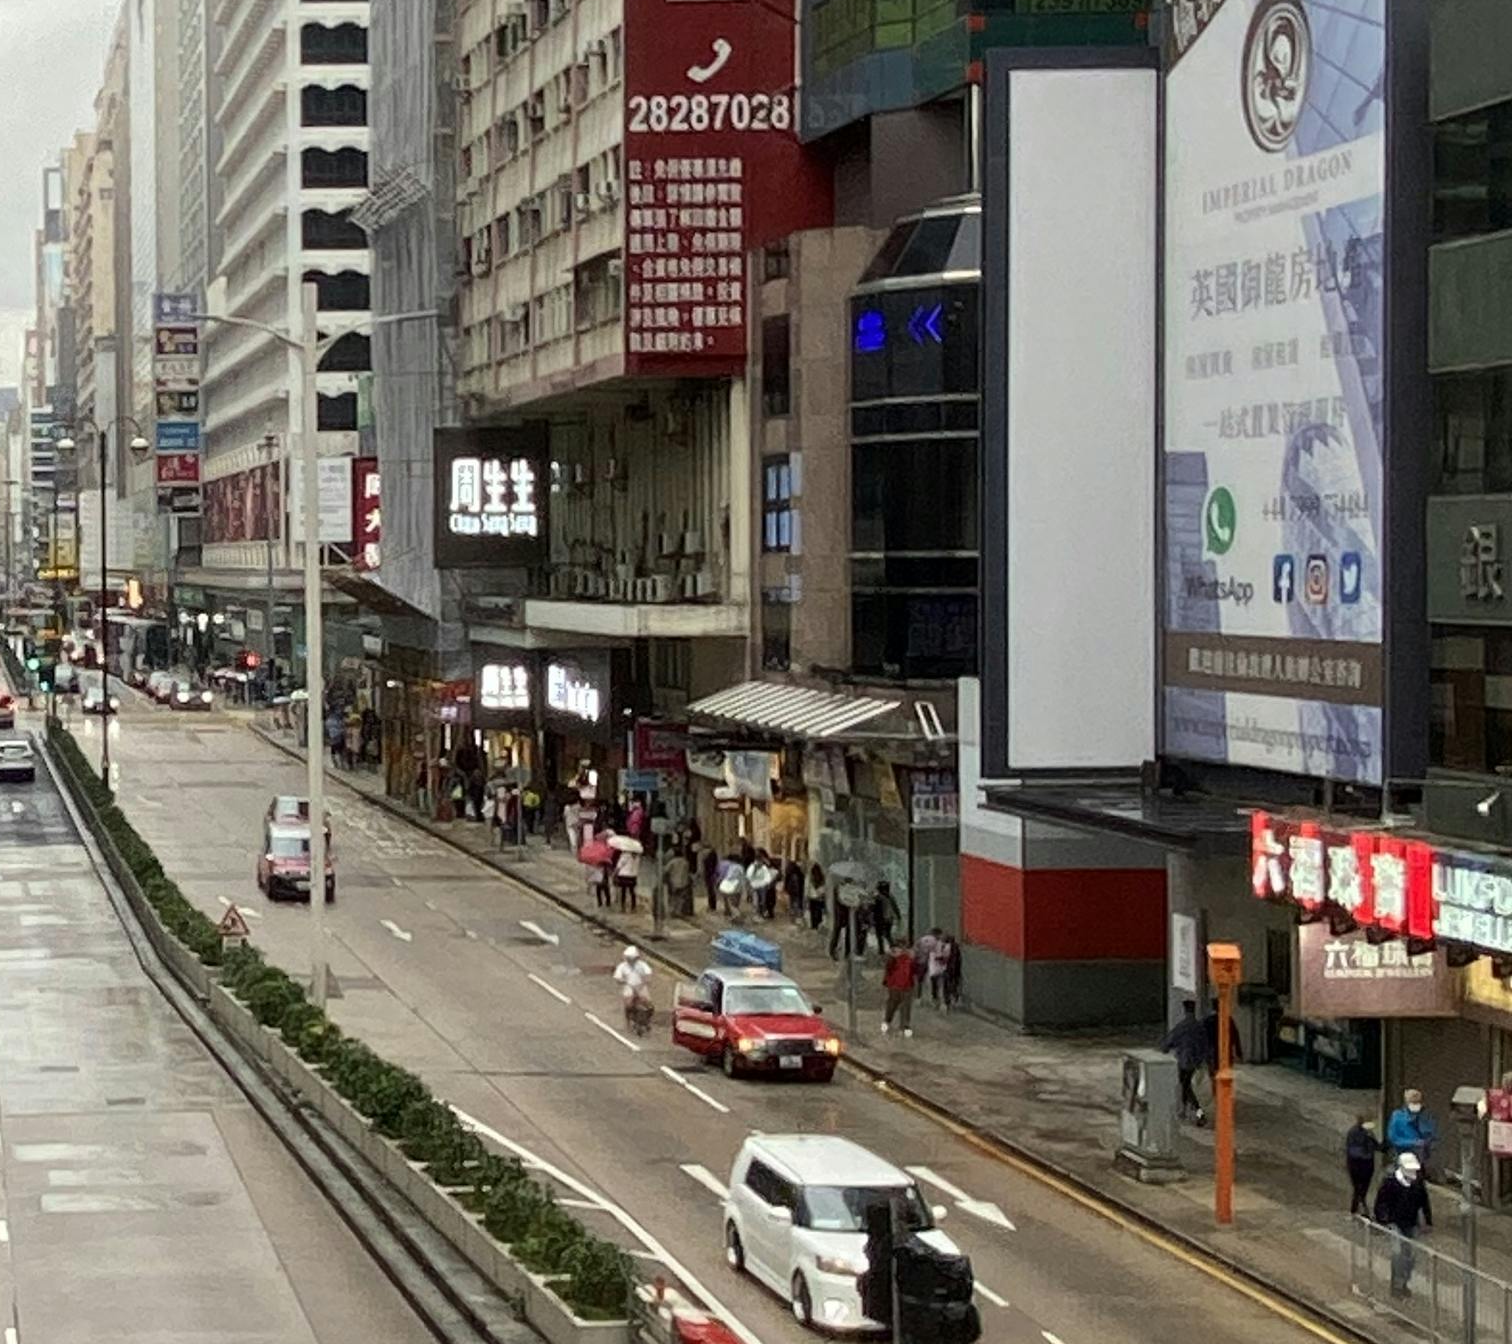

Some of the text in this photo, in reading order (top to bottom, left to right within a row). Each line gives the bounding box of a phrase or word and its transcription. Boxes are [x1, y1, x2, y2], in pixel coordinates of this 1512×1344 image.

[628, 93, 790, 133] 28287028
[1202, 175, 1278, 215] IMPERIAL
[1283, 150, 1354, 192] DRAGON
[450, 458, 535, 512] 周生生
[1185, 575, 1254, 607] WhatsApp
